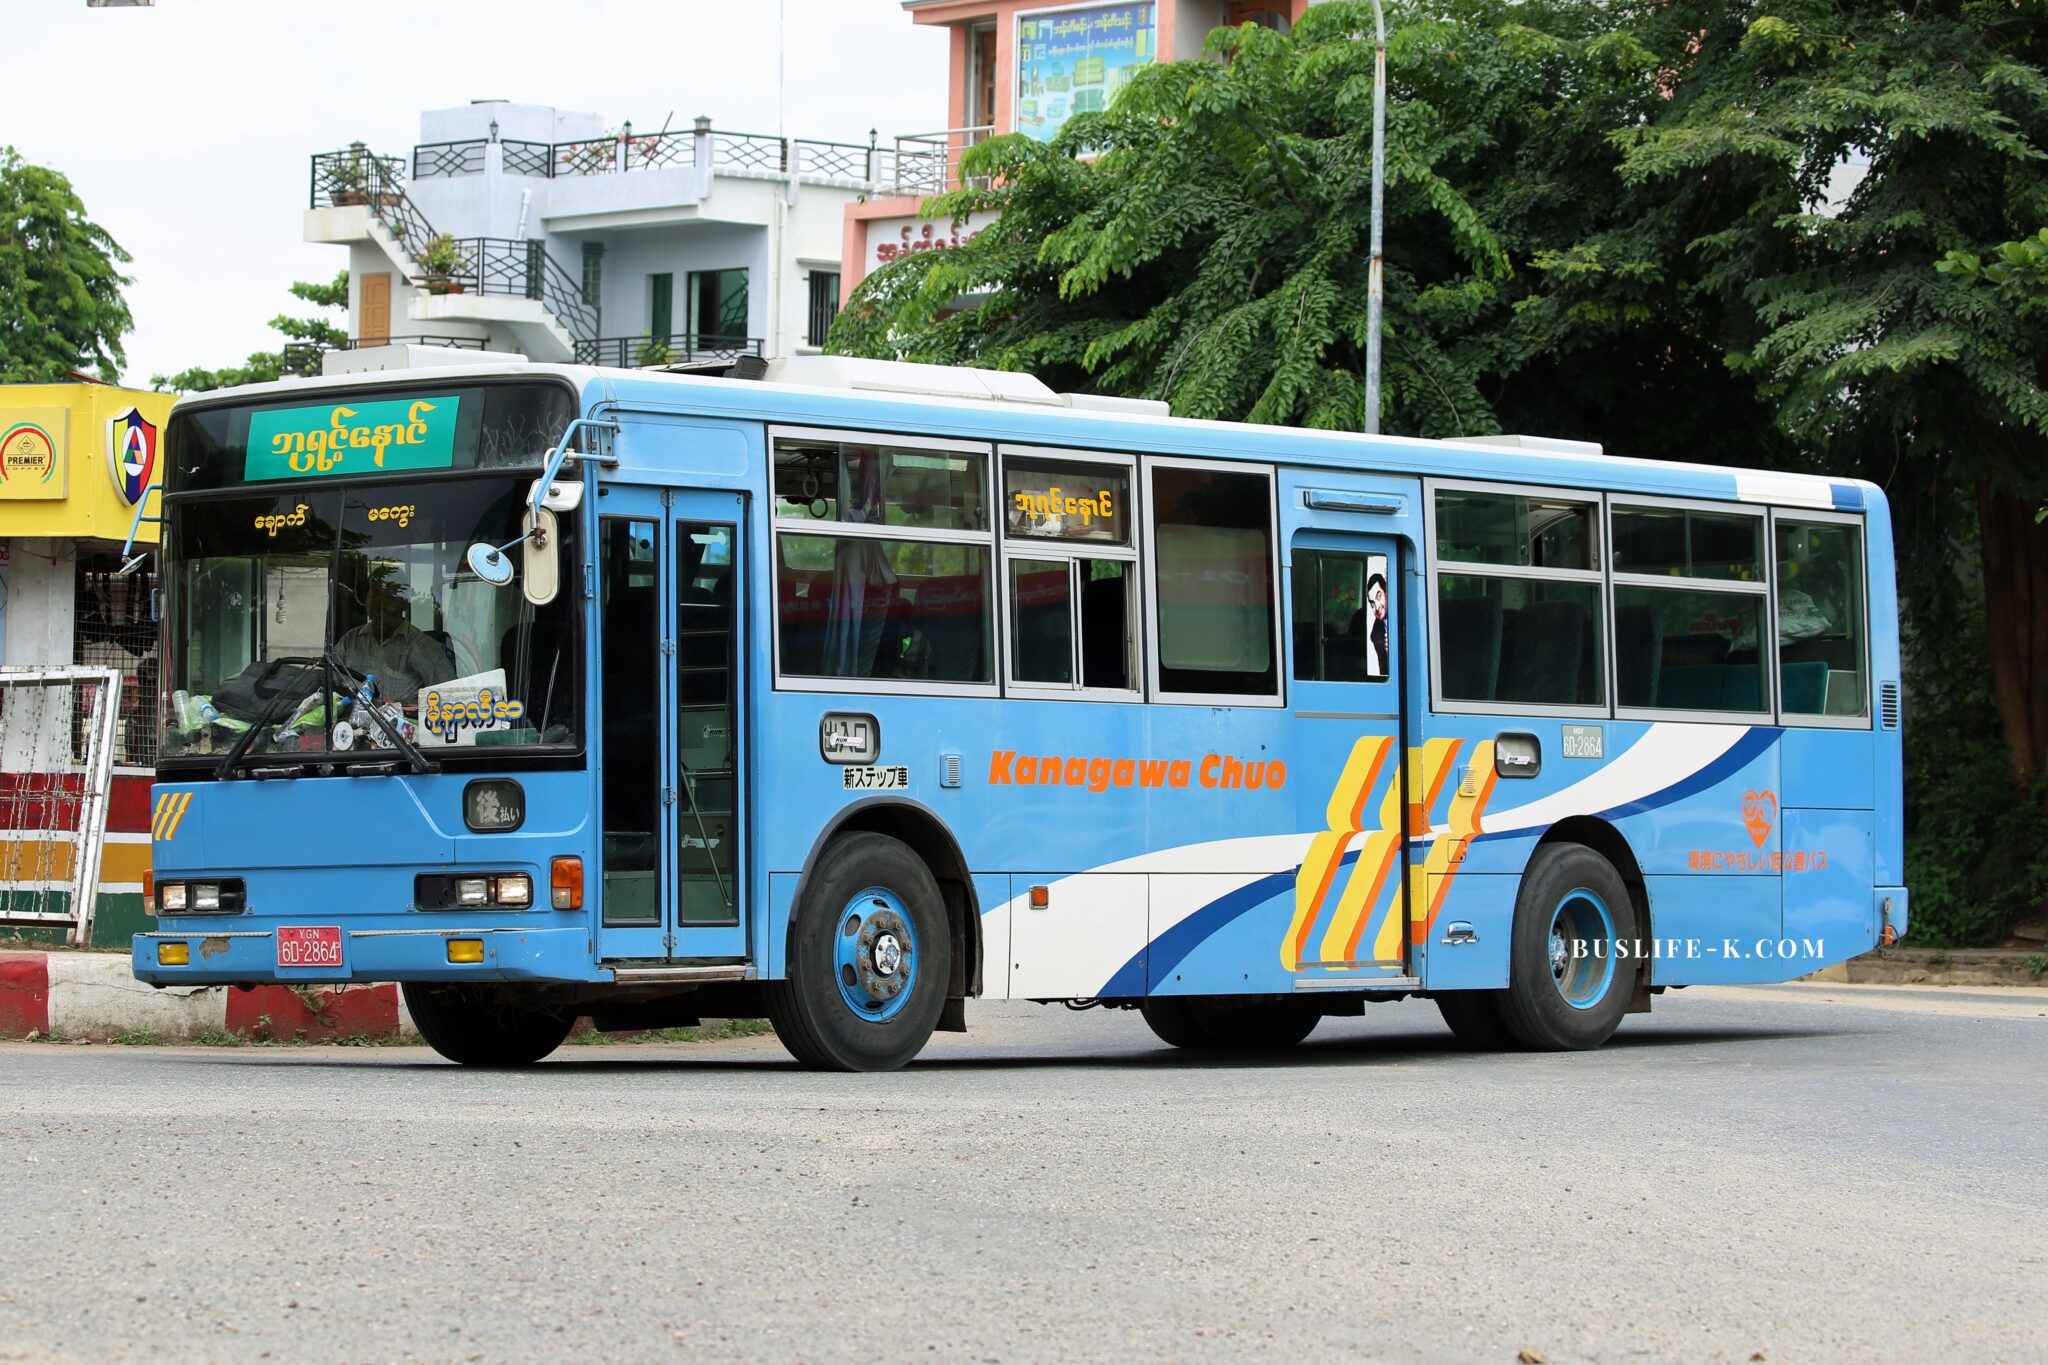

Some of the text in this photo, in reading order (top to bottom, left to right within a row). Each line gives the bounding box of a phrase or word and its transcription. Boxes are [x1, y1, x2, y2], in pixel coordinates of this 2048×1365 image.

[8, 456, 44, 465] PREMIER
[1564, 736, 1602, 756] 6D-2864
[844, 766, 908, 789] 新ステップ車
[988, 750, 1287, 793] Kanagawa Chuo
[1688, 850, 1829, 871] 環境にやさしい低公害バス
[299, 929, 320, 939] YGN
[282, 940, 338, 962] 6D-2864
